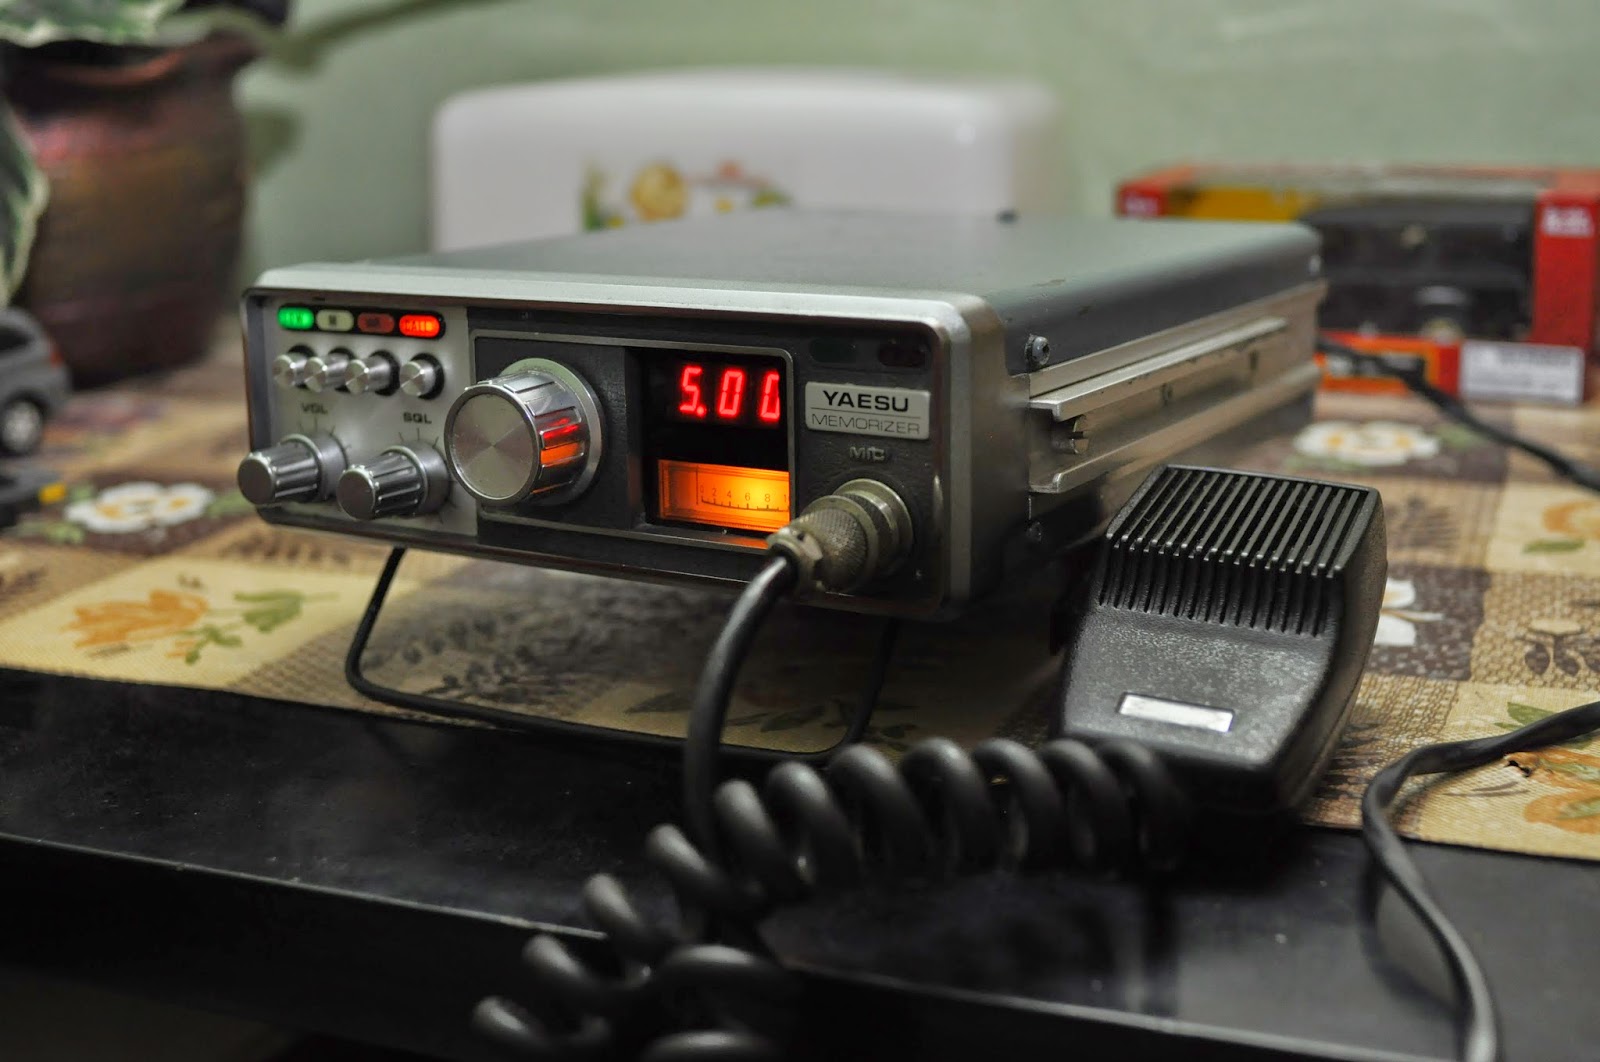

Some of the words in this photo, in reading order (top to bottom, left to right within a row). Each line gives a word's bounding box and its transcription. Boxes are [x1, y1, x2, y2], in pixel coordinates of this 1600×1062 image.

[822, 390, 909, 413] YAESU
[301, 403, 328, 414] VOL
[403, 412, 432, 424] SQL
[849, 446, 885, 461] MIC
[744, 492, 751, 502] 6
[764, 493, 771, 503] 8
